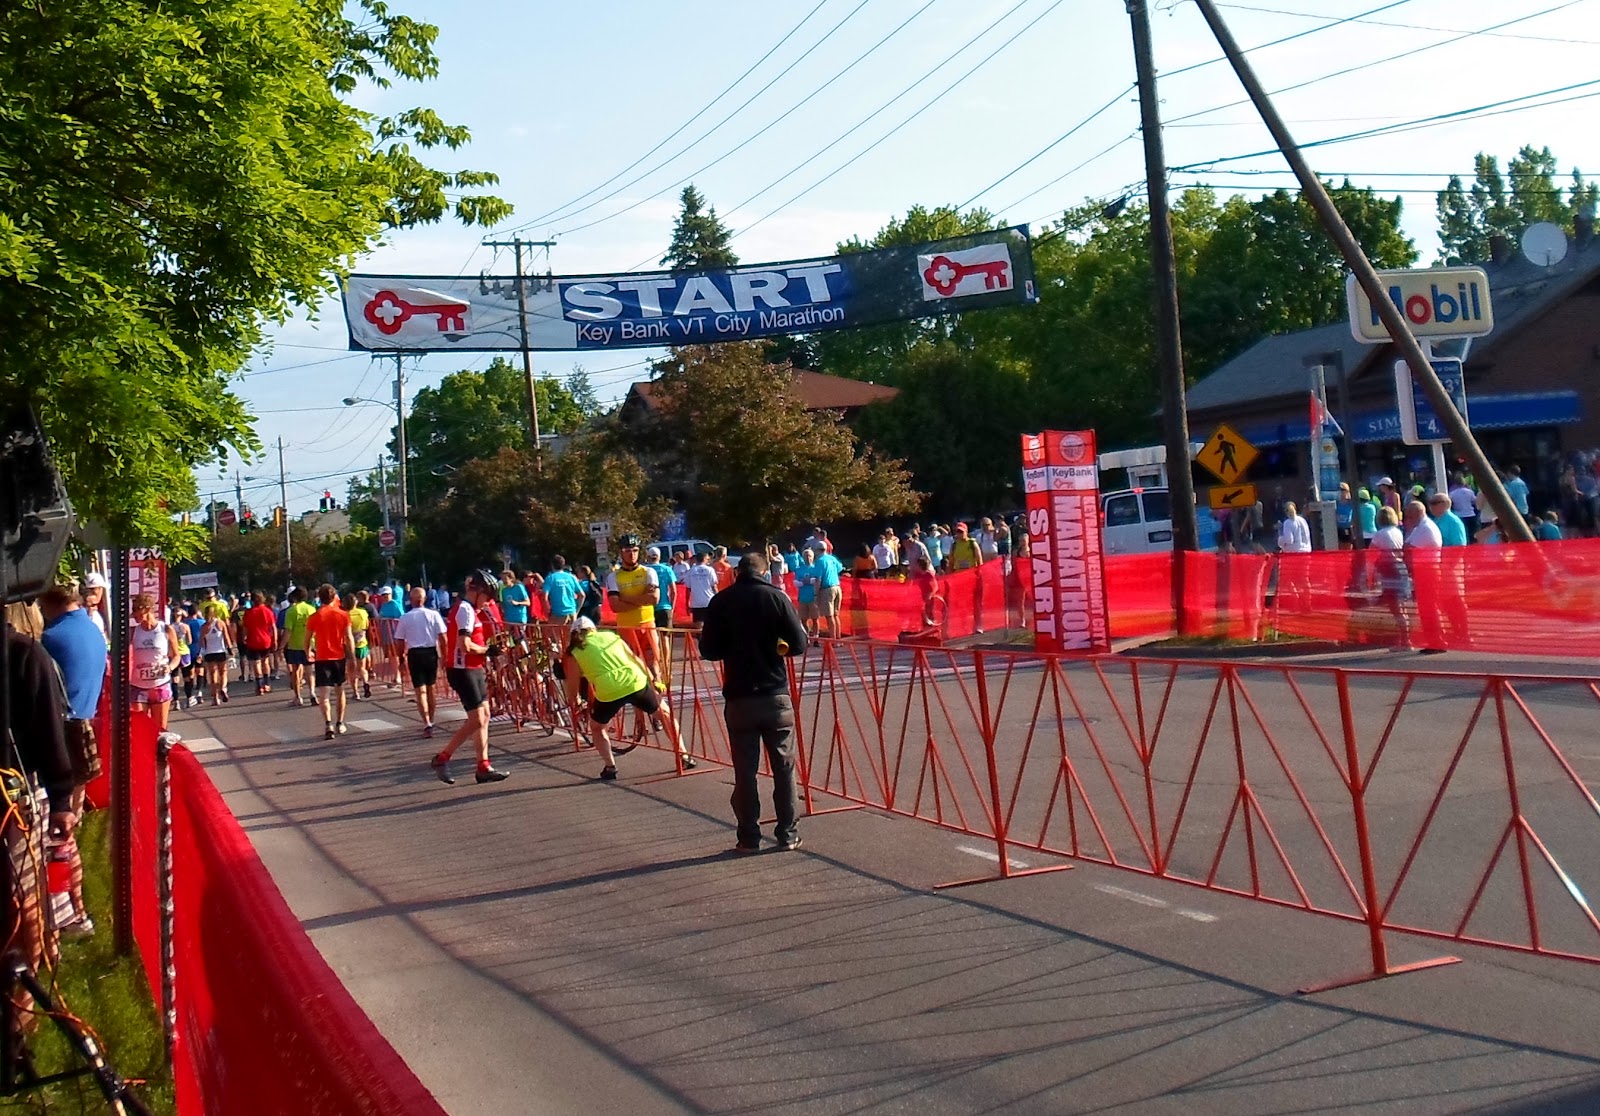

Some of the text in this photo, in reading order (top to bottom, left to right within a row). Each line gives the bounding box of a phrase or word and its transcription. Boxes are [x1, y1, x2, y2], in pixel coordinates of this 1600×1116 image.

[564, 264, 842, 320] START
[577, 305, 845, 346] Key Bank VT City Marathon
[1052, 467, 1093, 479] KeyBank
[1029, 508, 1056, 640] START
[1054, 495, 1092, 651] MARATHON
[1087, 554, 1105, 617] VERMONT
[1092, 617, 1108, 648] CITY
